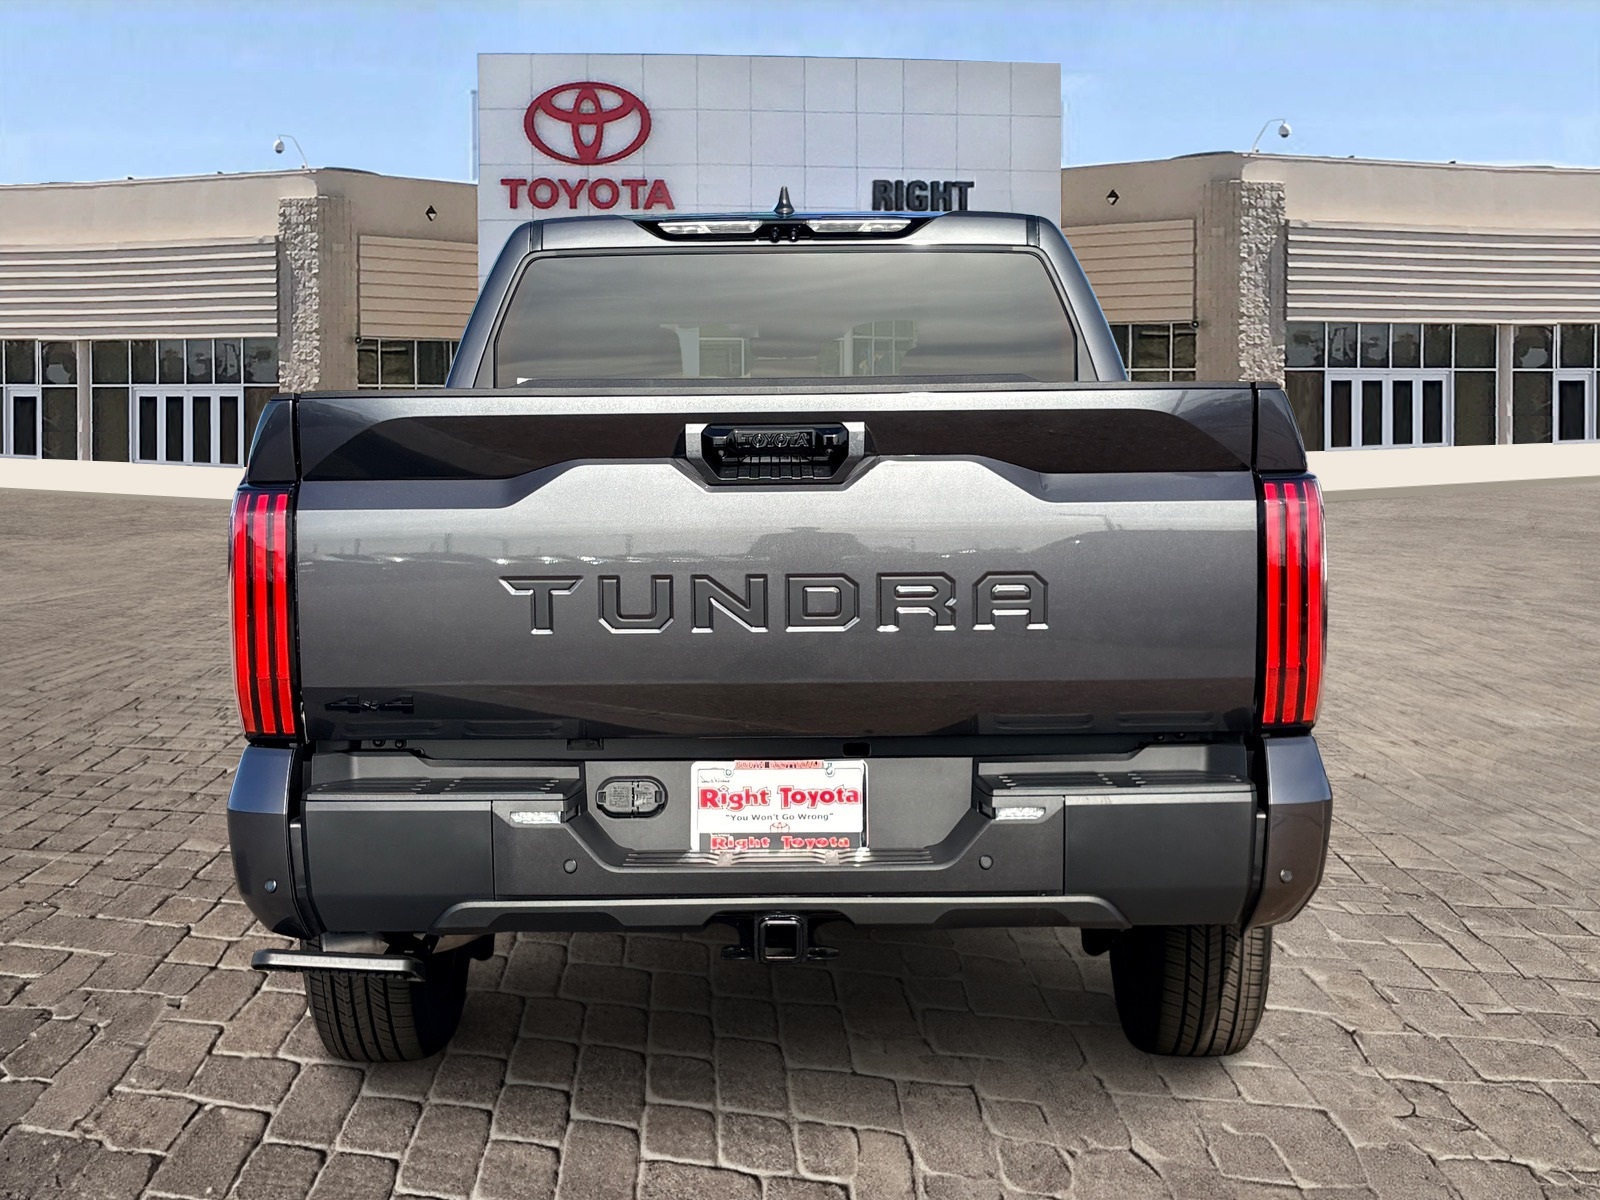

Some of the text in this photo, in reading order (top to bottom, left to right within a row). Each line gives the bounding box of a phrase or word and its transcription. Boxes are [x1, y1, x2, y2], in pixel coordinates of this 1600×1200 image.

[500, 178, 676, 211] TOYOTA
[871, 178, 975, 213] RIGHT
[742, 433, 811, 448] TOYOTA
[498, 571, 1049, 635] TUNDRA
[699, 785, 861, 811] Right Toyota
[752, 813, 779, 821] Won't
[710, 835, 850, 850] Right Toyota
